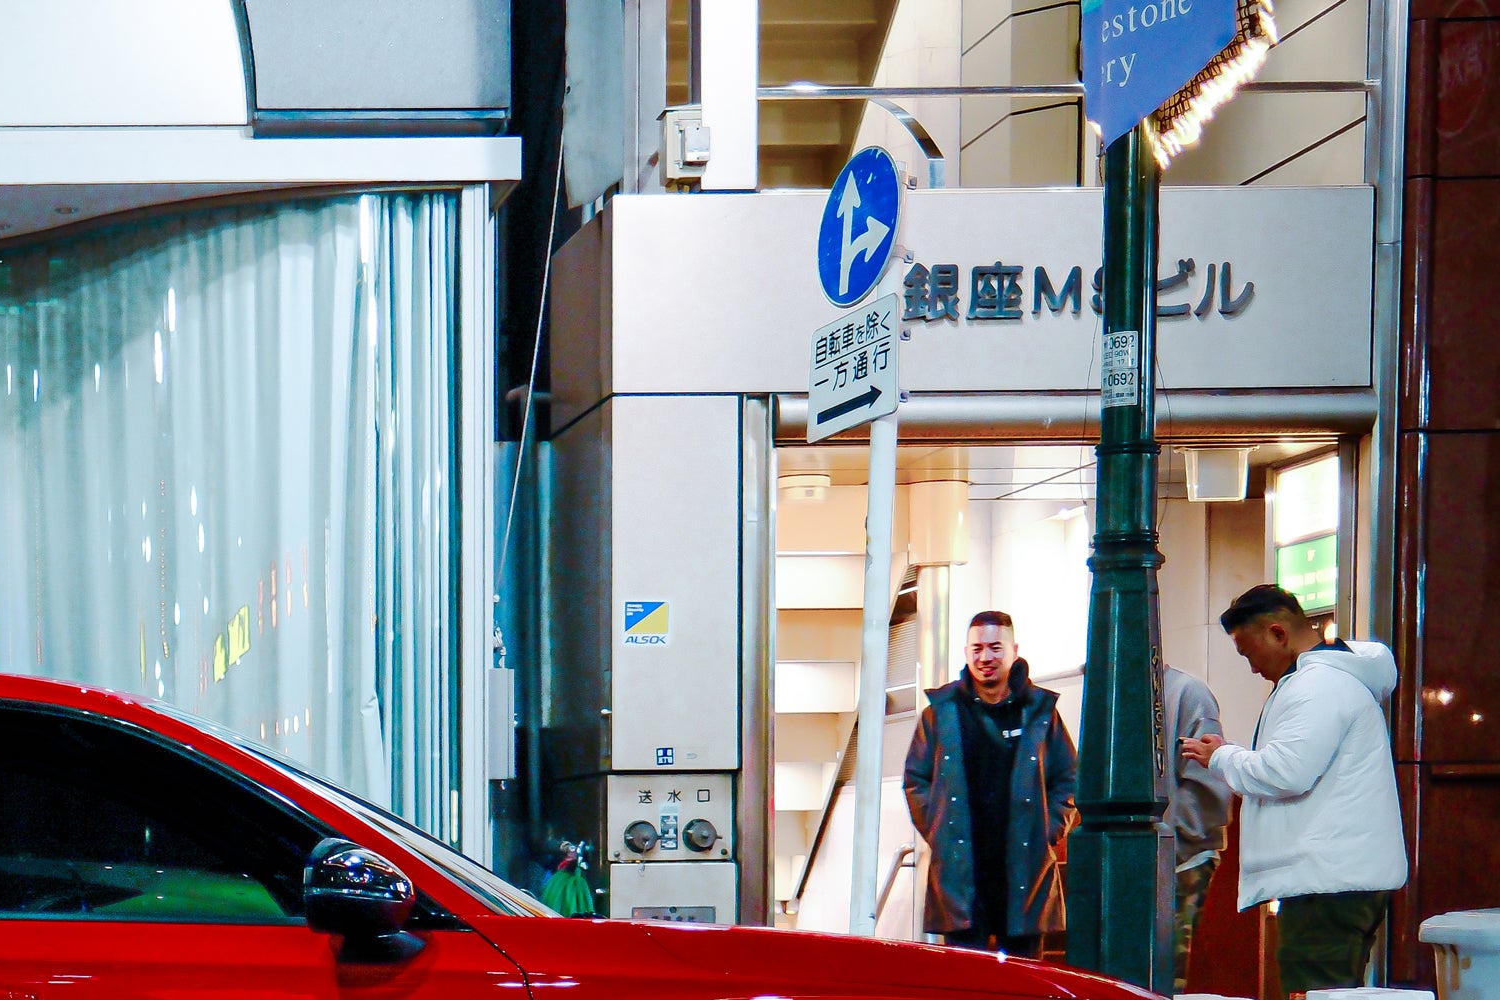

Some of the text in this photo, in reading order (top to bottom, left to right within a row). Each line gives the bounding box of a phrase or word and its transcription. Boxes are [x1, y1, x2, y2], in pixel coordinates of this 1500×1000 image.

[1101, 52, 1137, 88] ry
[902, 258, 1255, 321] 銀座Mビル
[815, 310, 891, 365] 自転車を除く
[814, 341, 891, 392] 一方通行
[1108, 372, 1134, 387] 0692
[624, 635, 667, 645] ALSOK
[638, 789, 711, 804] 送水口
